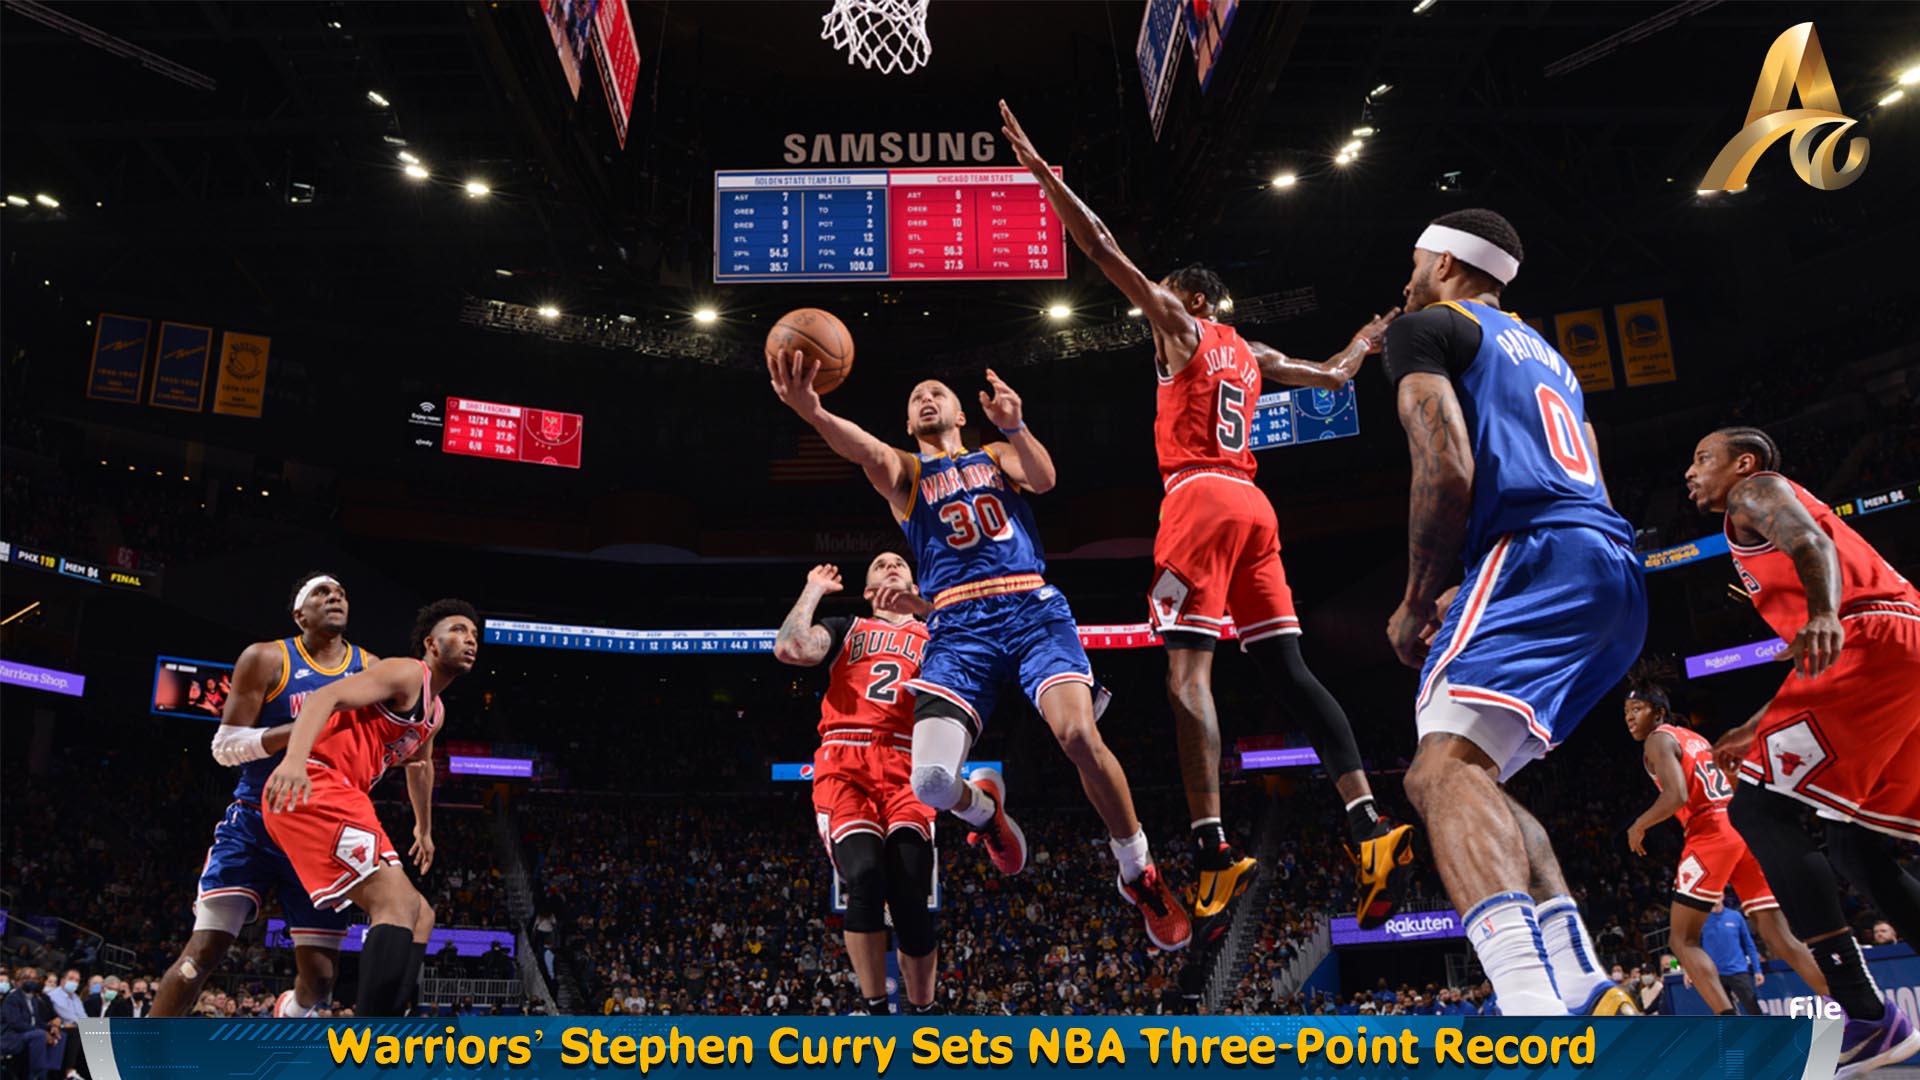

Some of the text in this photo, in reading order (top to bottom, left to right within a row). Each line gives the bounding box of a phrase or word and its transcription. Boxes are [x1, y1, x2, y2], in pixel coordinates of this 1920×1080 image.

[784, 132, 994, 164] SAMSUNG
[754, 176, 851, 186] GOLDEN STATE TEAM STATS
[937, 174, 1014, 183] CHICAGO TEAM STATS
[782, 192, 789, 201] 7
[867, 191, 873, 200] 2
[782, 206, 789, 215] 3
[867, 205, 873, 214] 7
[956, 204, 962, 214] 2
[1040, 203, 1046, 212] 5
[867, 219, 873, 228] 2
[952, 218, 962, 227] 10
[782, 234, 789, 243] 3
[863, 233, 873, 242] 12
[956, 232, 962, 241] 2
[1037, 231, 1047, 240] 14
[770, 248, 788, 258] 54.5
[853, 247, 873, 257] 44.0
[770, 262, 788, 272] 35.7
[850, 261, 874, 271] 100.0
[1029, 259, 1048, 269] 75.0
[1204, 346, 1238, 376] JONE
[1216, 380, 1245, 453] 5
[1535, 382, 1596, 486] 0
[1864, 494, 1889, 508] MEM
[939, 493, 1014, 550] 30
[18, 550, 38, 563] PHX
[65, 562, 86, 574] MEM
[87, 567, 98, 578] 94
[110, 573, 141, 586] FINAL
[495, 631, 500, 640] 7
[585, 638, 590, 646] 2
[608, 639, 612, 648] 7
[629, 641, 634, 650] 2
[650, 641, 658, 650] 12
[672, 641, 689, 650] 54.5
[701, 641, 718, 650] 35.7
[759, 641, 774, 649] 100.
[1755, 645, 1774, 658] Get
[866, 661, 902, 704] 2
[1695, 760, 1734, 800] 12
[1385, 916, 1453, 935] Rakuten
